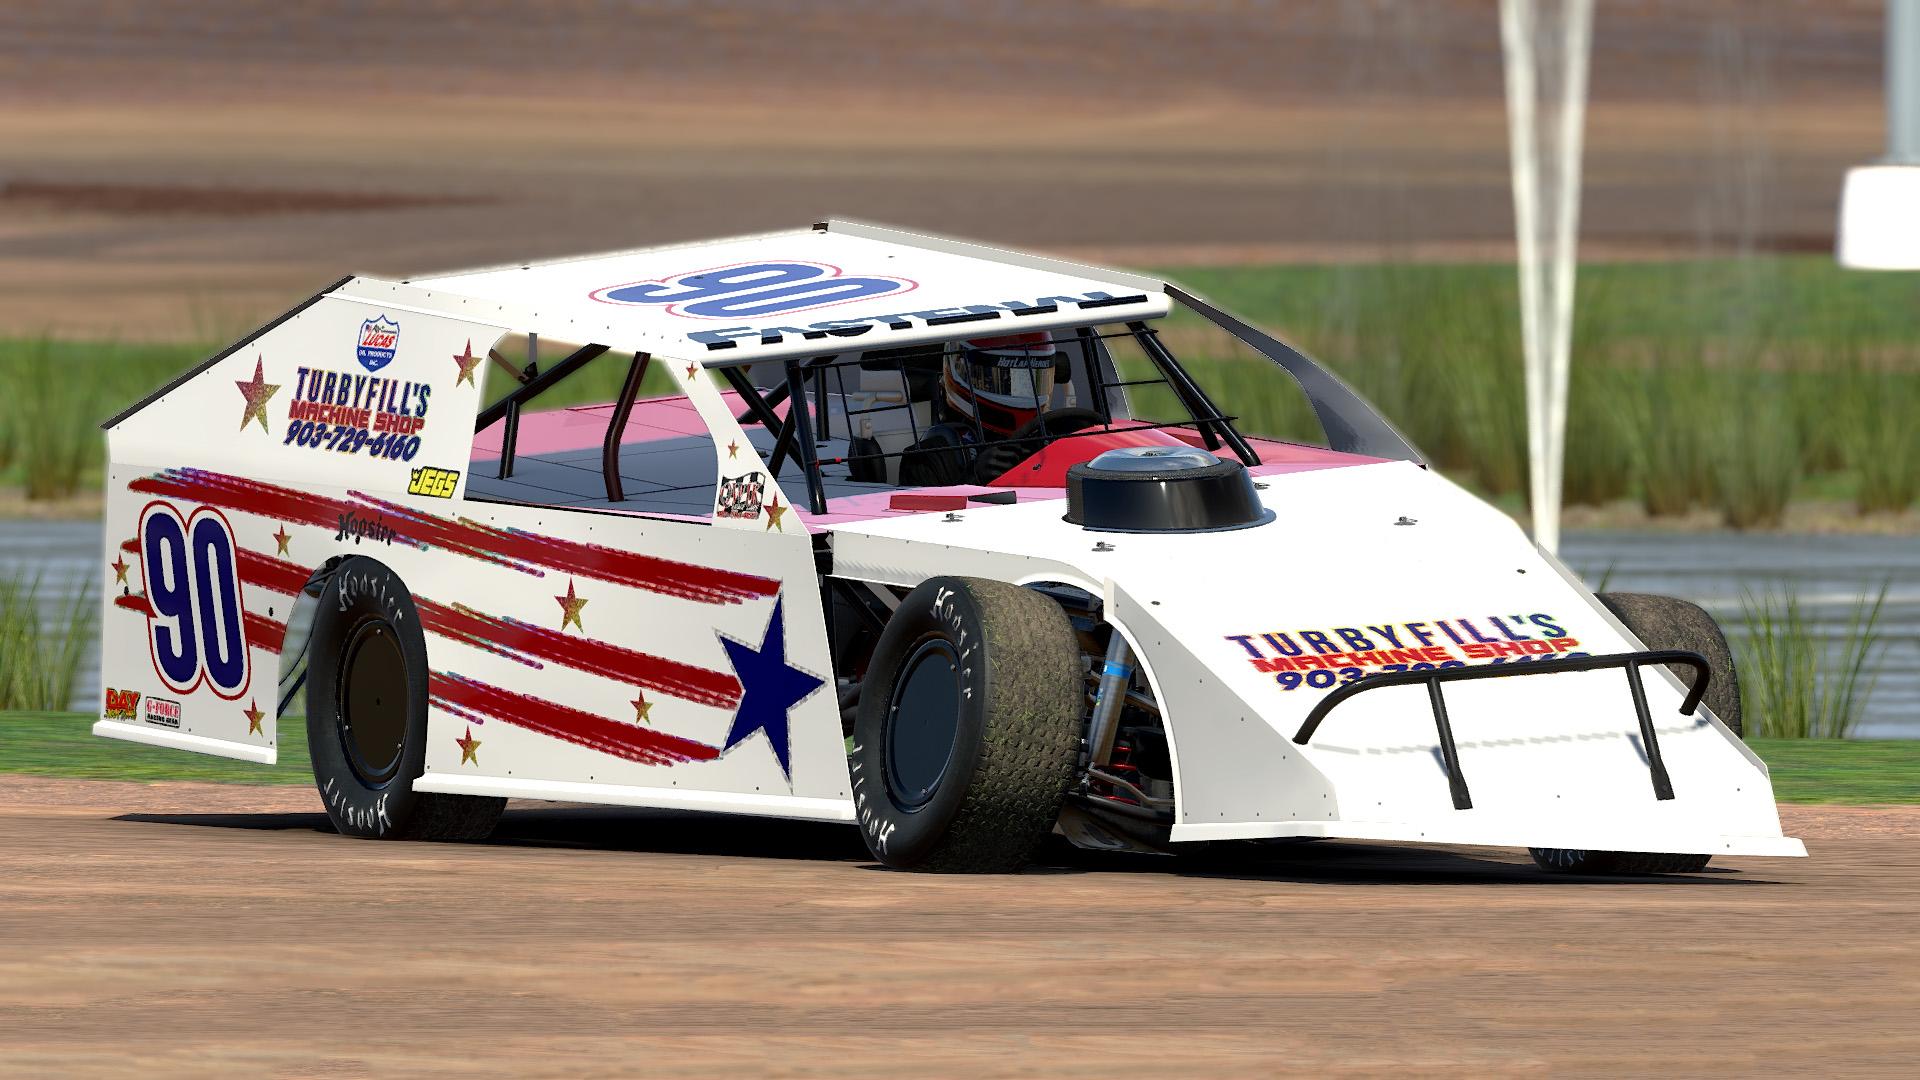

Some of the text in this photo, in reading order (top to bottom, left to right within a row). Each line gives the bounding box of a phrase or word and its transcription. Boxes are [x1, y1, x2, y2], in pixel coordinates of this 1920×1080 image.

[606, 263, 902, 318] 90
[687, 291, 1149, 351] FASTENAL
[362, 331, 396, 349] LUCAS
[367, 350, 393, 359] PRODUCTS
[295, 366, 432, 418] TURBYFILL'S
[288, 399, 426, 435] MACHINE SHOP
[283, 420, 422, 462] 903-729-6160
[409, 468, 459, 499] JEGS
[335, 511, 397, 546] Hoosier
[144, 511, 245, 690] 90
[1224, 613, 1569, 660] TURBYFILL'S
[1249, 646, 1455, 673] MACHINE
[1460, 637, 1580, 660] SHOP
[106, 688, 141, 712] DAY
[146, 700, 180, 719] G-FORCE
